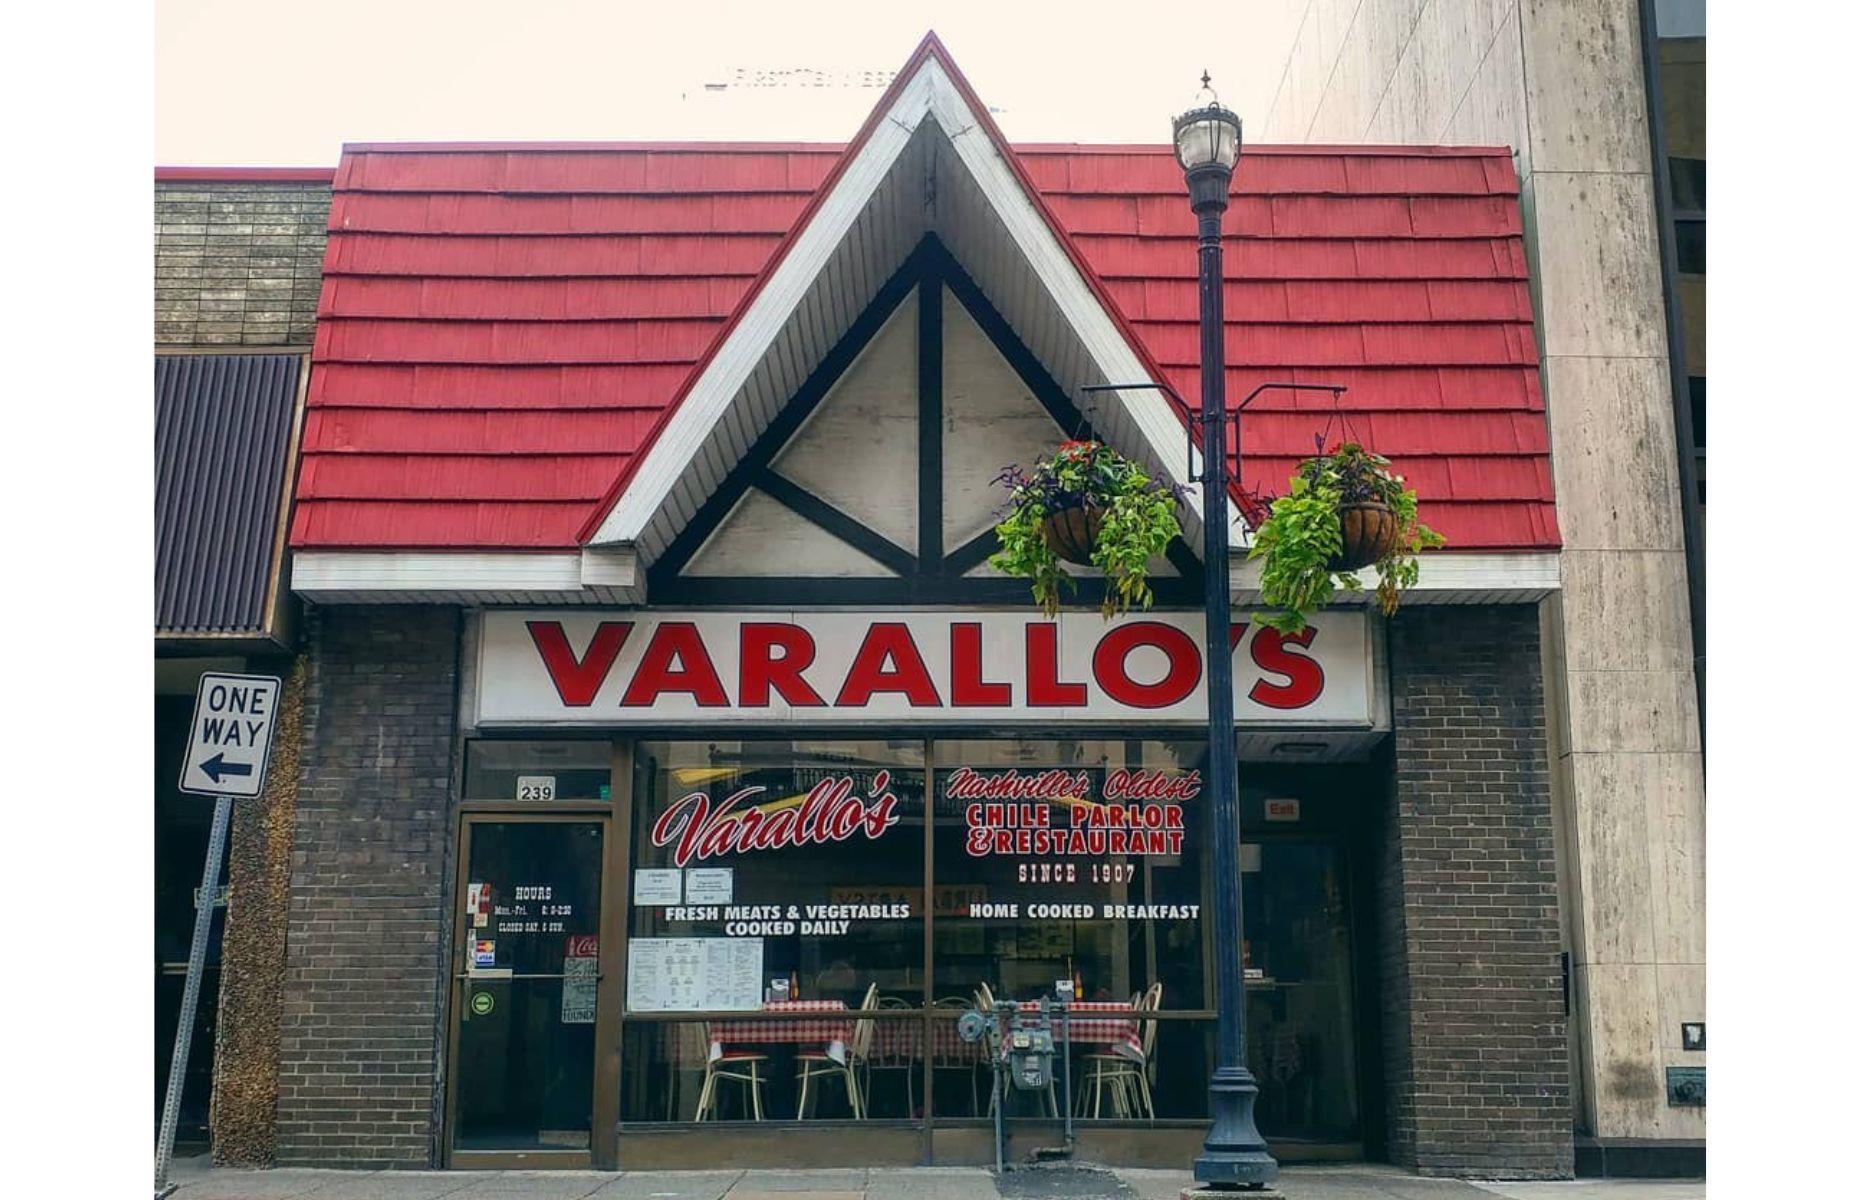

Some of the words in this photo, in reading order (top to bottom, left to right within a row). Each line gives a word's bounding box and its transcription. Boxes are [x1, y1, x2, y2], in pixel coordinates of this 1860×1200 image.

[209, 685, 268, 715] ONE
[203, 717, 264, 747] WAY
[947, 767, 1090, 800] Nashville's
[1103, 768, 1201, 800] Oldest
[521, 786, 552, 800] 239
[966, 804, 1050, 829] CHILE
[1070, 804, 1184, 829] PARLOR
[1270, 803, 1294, 815] Exit
[652, 769, 899, 868] Varallo's
[1018, 864, 1076, 883] SINCE
[1092, 864, 1135, 883] 1907
[515, 886, 552, 900] HOURS
[665, 906, 718, 921] FRESH
[724, 905, 781, 920] MEATS
[786, 905, 800, 919] &
[806, 904, 910, 920] VEGETABLES
[970, 904, 1018, 918] HOME
[1027, 904, 1094, 918] COOKED
[1103, 905, 1200, 920] BREAKFAST
[725, 921, 795, 936] COOKED
[800, 920, 850, 936] DAILY
